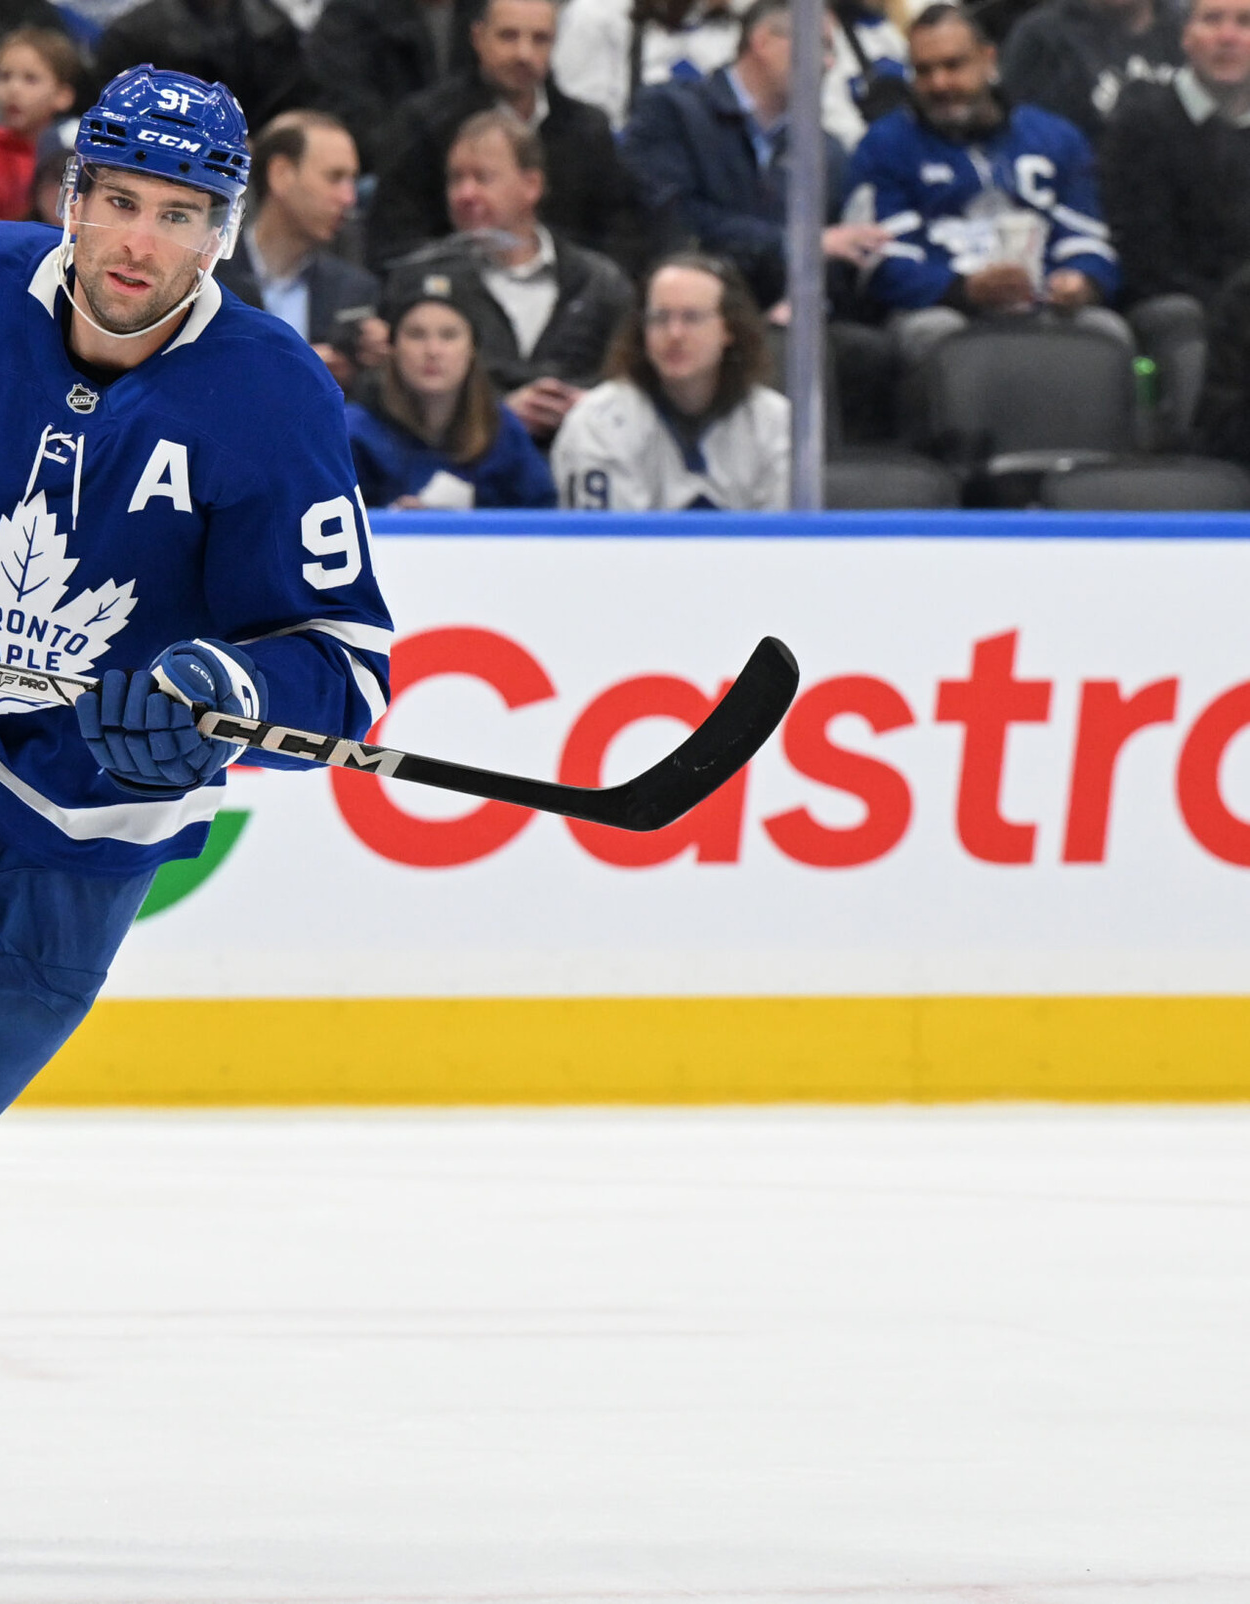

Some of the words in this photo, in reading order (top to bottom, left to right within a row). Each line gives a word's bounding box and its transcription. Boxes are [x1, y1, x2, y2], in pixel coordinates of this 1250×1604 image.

[157, 88, 190, 116] 91
[137, 129, 202, 153] CCM
[1014, 153, 1057, 210] C
[127, 438, 193, 514] A
[18, 676, 49, 692] PRO
[197, 711, 406, 778] CCM
